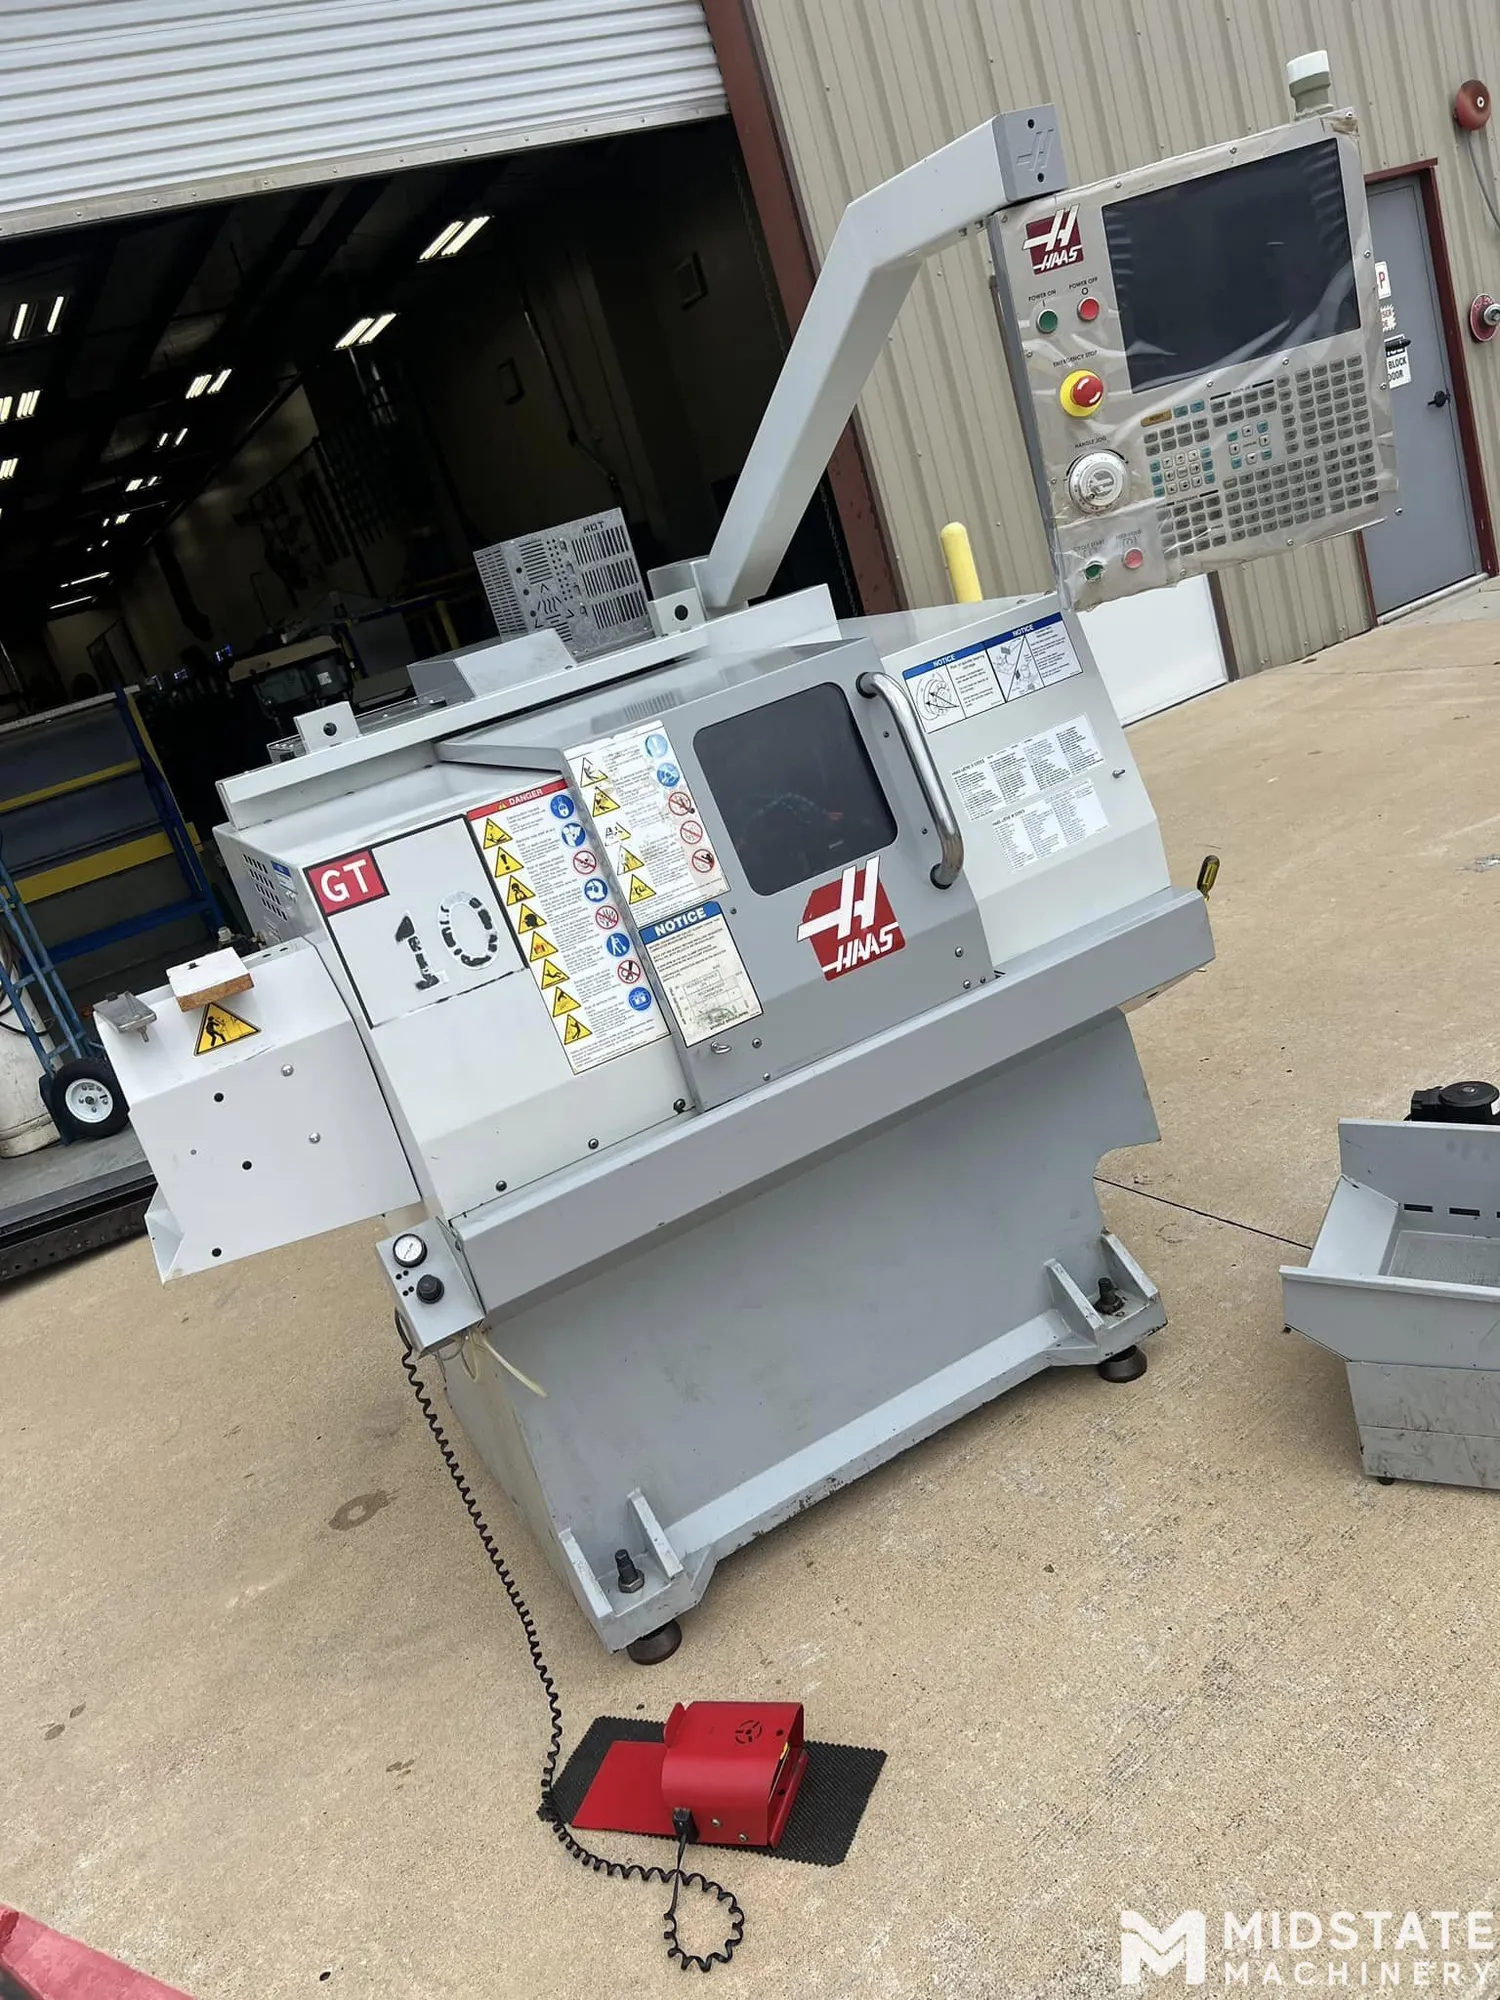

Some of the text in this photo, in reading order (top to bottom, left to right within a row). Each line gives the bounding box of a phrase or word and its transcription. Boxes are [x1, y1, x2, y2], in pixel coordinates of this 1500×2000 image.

[1033, 244, 1083, 271] HAAS
[1068, 276, 1099, 290] POWER OFF
[1028, 288, 1057, 302] POWER ON
[1388, 356, 1408, 370] BLOCK
[582, 520, 605, 534] HOT
[1012, 624, 1034, 638] NOTICE
[932, 653, 956, 668] NOTICE
[508, 788, 544, 806] DANGER
[320, 859, 368, 903] GT
[654, 907, 707, 937] NOTICE
[394, 890, 499, 992] 10
[821, 921, 900, 973] HAAS
